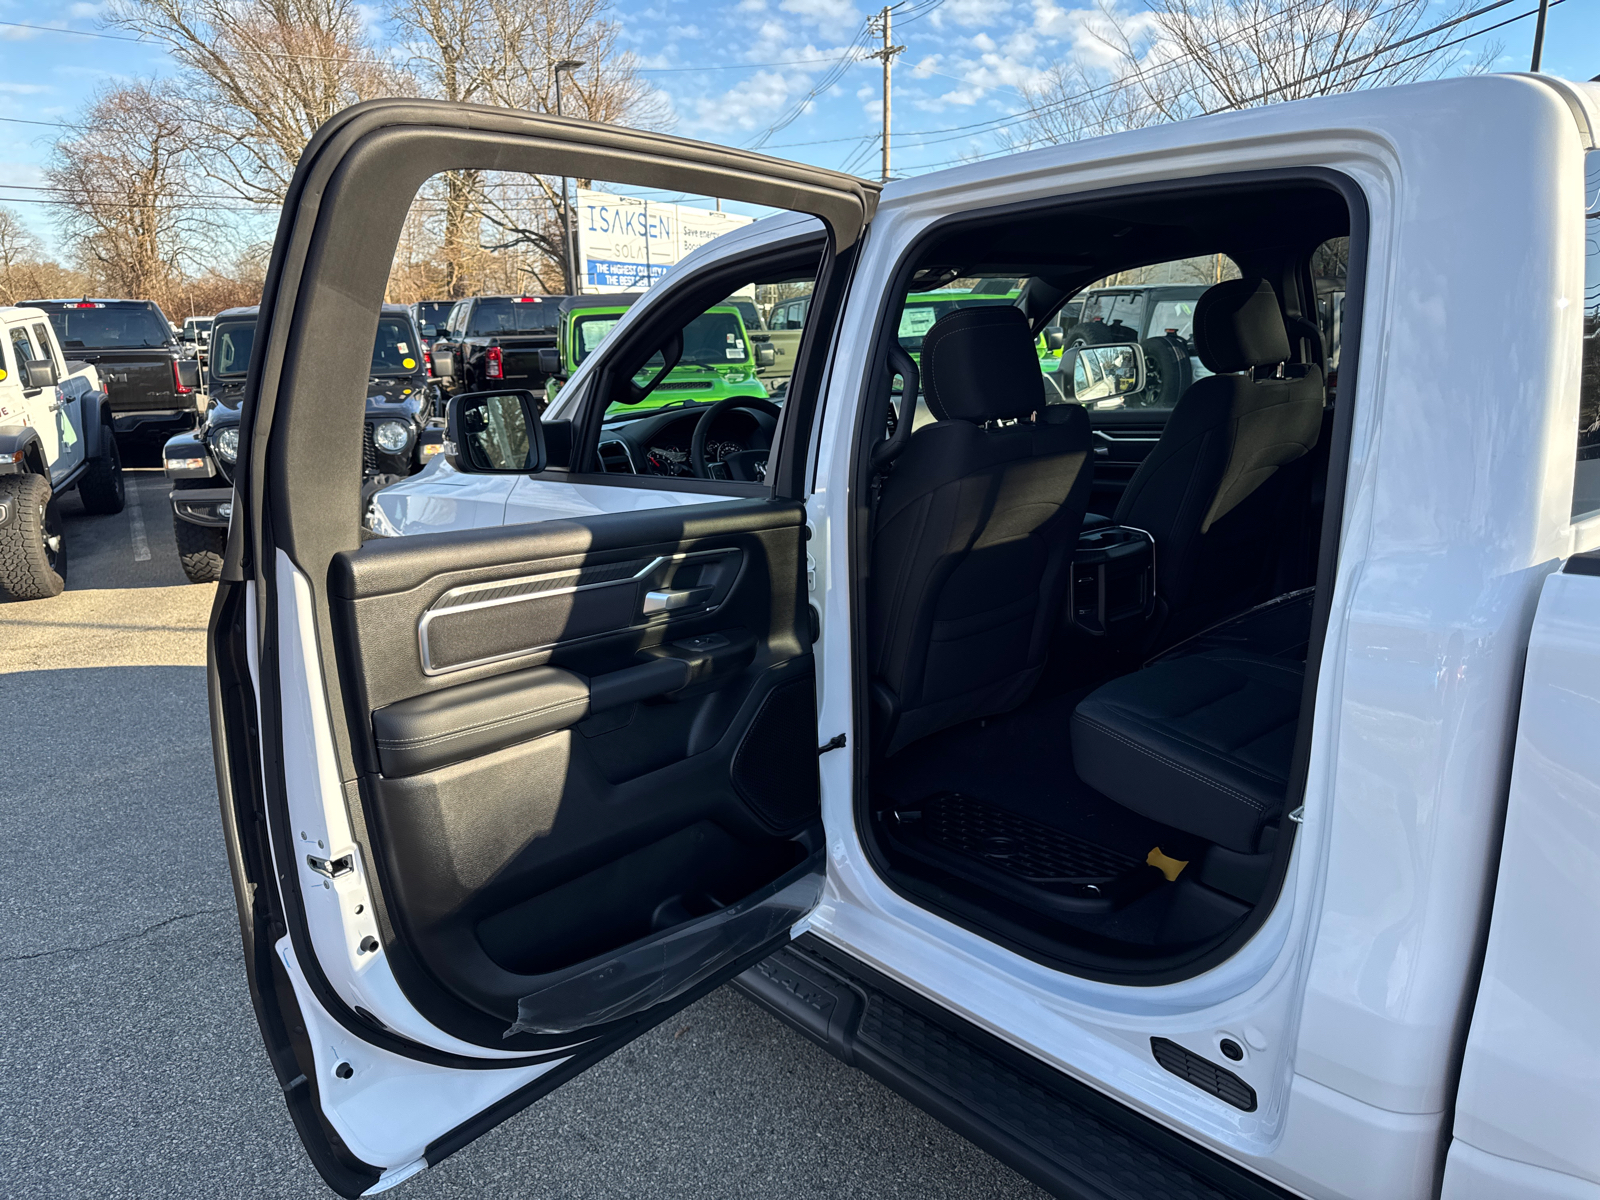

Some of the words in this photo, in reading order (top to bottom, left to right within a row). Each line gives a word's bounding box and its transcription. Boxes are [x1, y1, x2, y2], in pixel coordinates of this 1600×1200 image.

[587, 205, 671, 240] ISAKSEN
[614, 243, 649, 260] SOLA
[595, 262, 610, 274] THE
[610, 264, 637, 276] HIGHEST
[605, 274, 619, 285] THE
[619, 275, 635, 286] BEST
